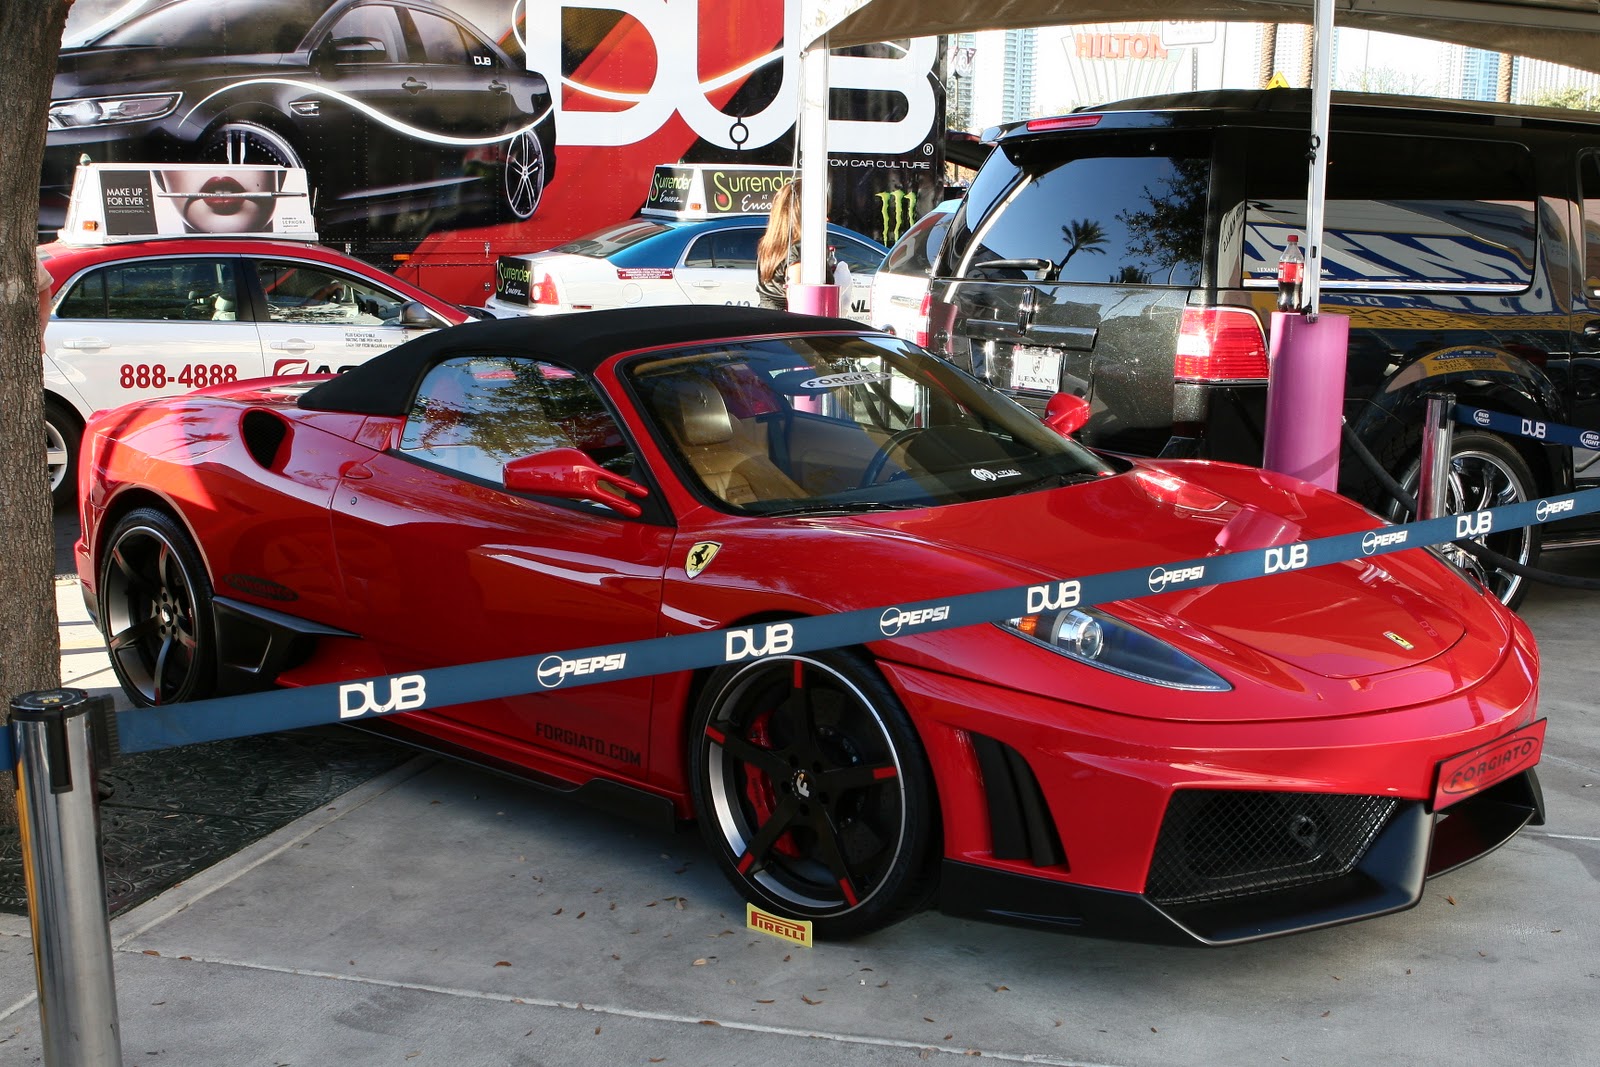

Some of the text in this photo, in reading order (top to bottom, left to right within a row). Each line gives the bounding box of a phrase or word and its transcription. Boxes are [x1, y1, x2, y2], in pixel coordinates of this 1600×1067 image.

[1076, 33, 1168, 59] HILTON
[474, 56, 491, 65] DUB
[526, 0, 939, 154] DUB
[876, 161, 930, 169] CULTURE
[106, 188, 143, 196] MAKE UP
[107, 197, 144, 205] FOR EVER
[714, 171, 802, 211] Surrend
[741, 194, 773, 212] Enco
[120, 364, 237, 389] 888-4888
[1018, 375, 1055, 385] LEXANI
[1522, 419, 1546, 439] DUB
[1586, 433, 1600, 441] BUD
[1583, 438, 1600, 446] LIGHT
[340, 499, 1574, 718] DUB PEPSI DUB PEPSI DUB PEPSI DUB PEPSI DUB PEPSI
[535, 722, 642, 767] FORGIATO.COM
[1450, 741, 1532, 789] FORGIATO
[751, 911, 805, 941] PIRELLI
